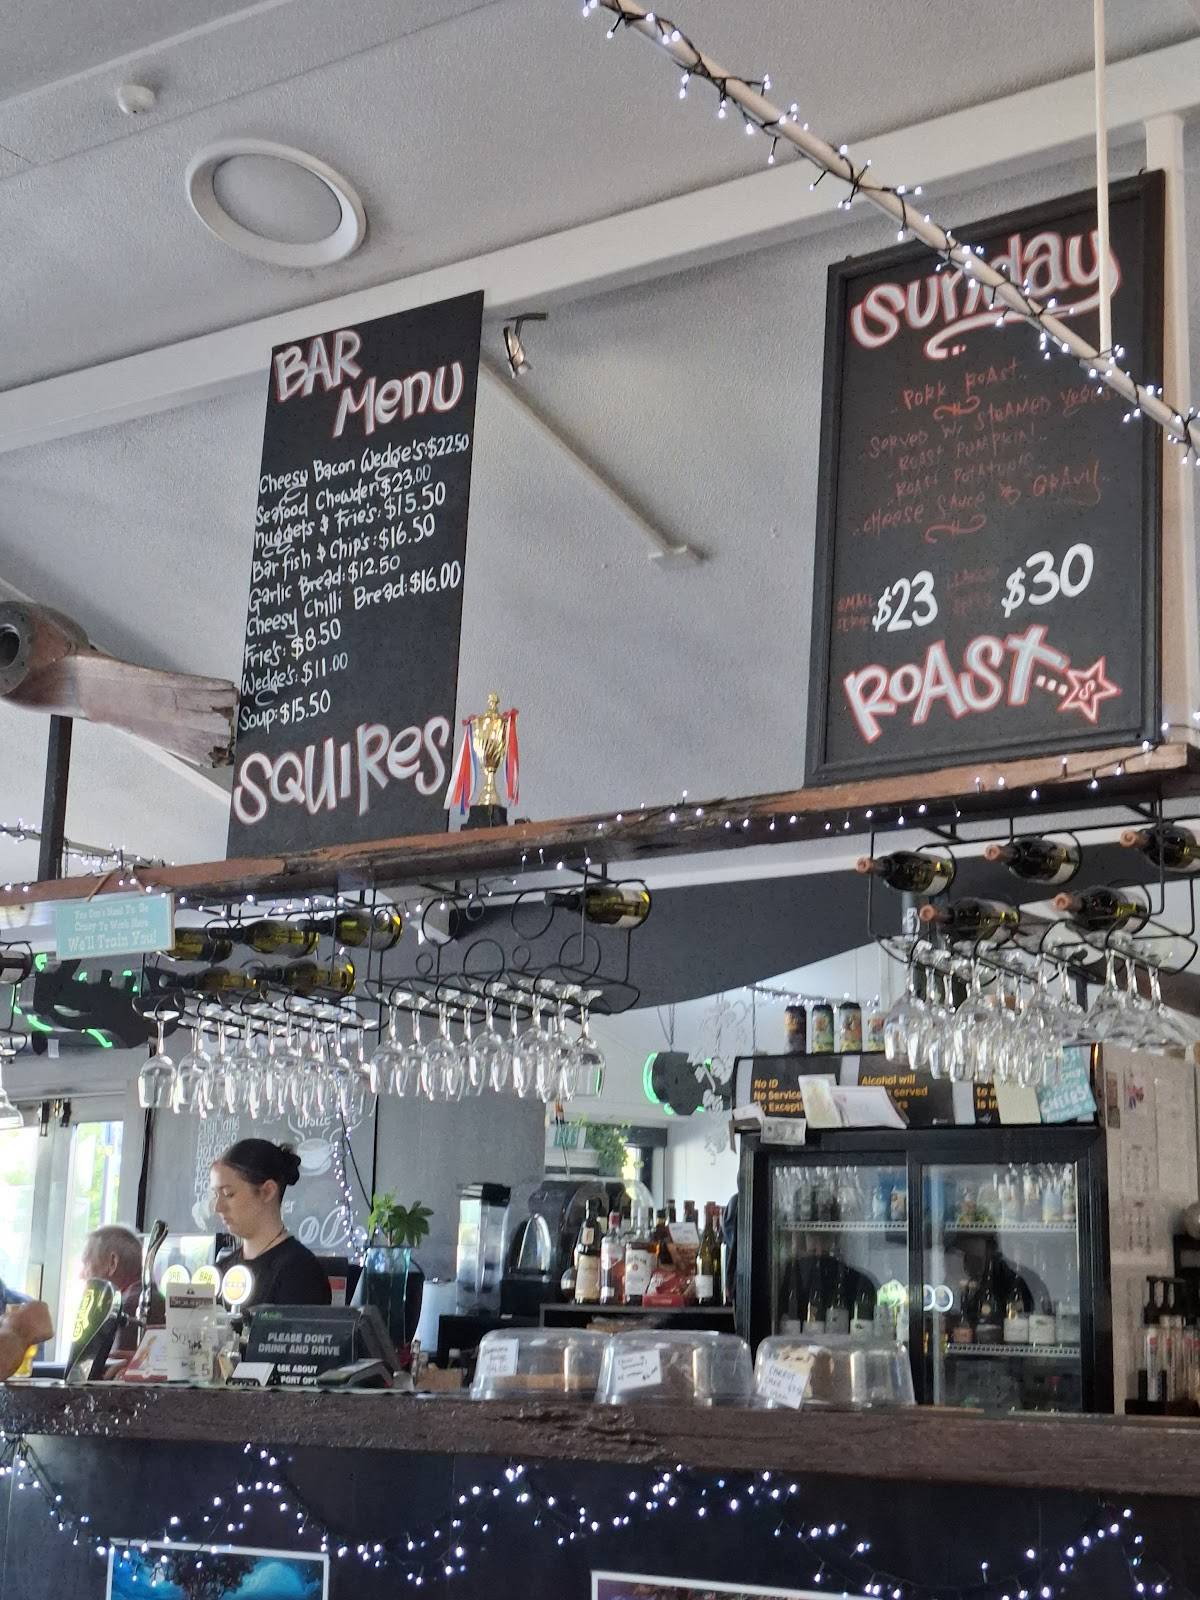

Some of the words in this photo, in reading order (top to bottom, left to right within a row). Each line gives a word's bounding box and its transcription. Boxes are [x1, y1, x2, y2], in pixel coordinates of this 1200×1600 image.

[273, 330, 362, 402] BAR
[259, 469, 308, 501] Cheesy
[313, 457, 355, 482] Bacon
[256, 493, 308, 527] Seafood
[384, 481, 446, 520] $15.50
[252, 558, 279, 583] Bar
[379, 513, 436, 551] $16.50
[1001, 543, 1094, 618] $30
[246, 607, 298, 638] Cheesy
[304, 591, 342, 618] Chilli
[409, 560, 462, 594] $16.00
[249, 583, 292, 616] Garlic
[872, 570, 938, 632] $23
[291, 618, 341, 660] $8.50
[301, 652, 348, 687] $11.00
[279, 688, 331, 724] $15.50
[99, 933, 128, 950] Train
[753, 1091, 766, 1100] No
[754, 1079, 767, 1088] No
[768, 1079, 778, 1088] ID
[258, 1343, 287, 1354] DRINK
[289, 1344, 308, 1355] AND
[311, 1345, 340, 1356] DRIVE
[268, 1332, 302, 1343] PLEASE
[304, 1333, 333, 1344] DON'T
